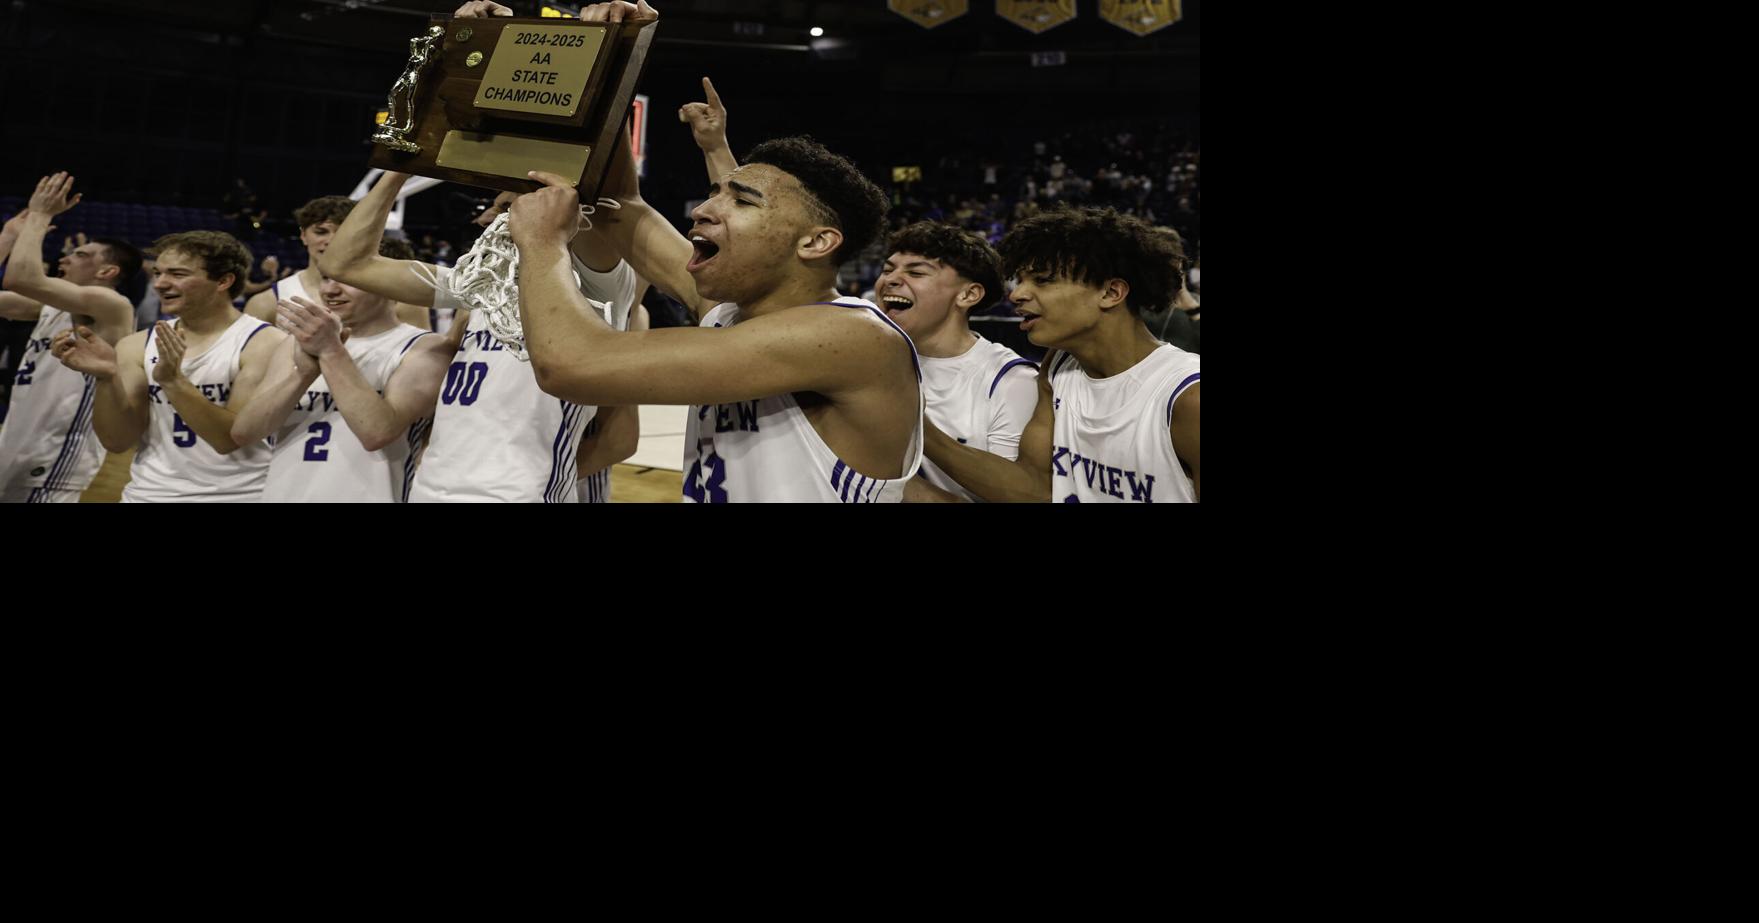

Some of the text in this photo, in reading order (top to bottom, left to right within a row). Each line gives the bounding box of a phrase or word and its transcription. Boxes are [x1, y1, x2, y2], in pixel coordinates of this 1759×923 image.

[515, 33, 585, 47] 2024-2025
[530, 52, 551, 65] AA
[512, 70, 558, 85] STATE
[484, 87, 572, 107] CHAMPIONS
[442, 362, 488, 406] 00
[173, 412, 197, 448] 5
[303, 421, 332, 462] 2
